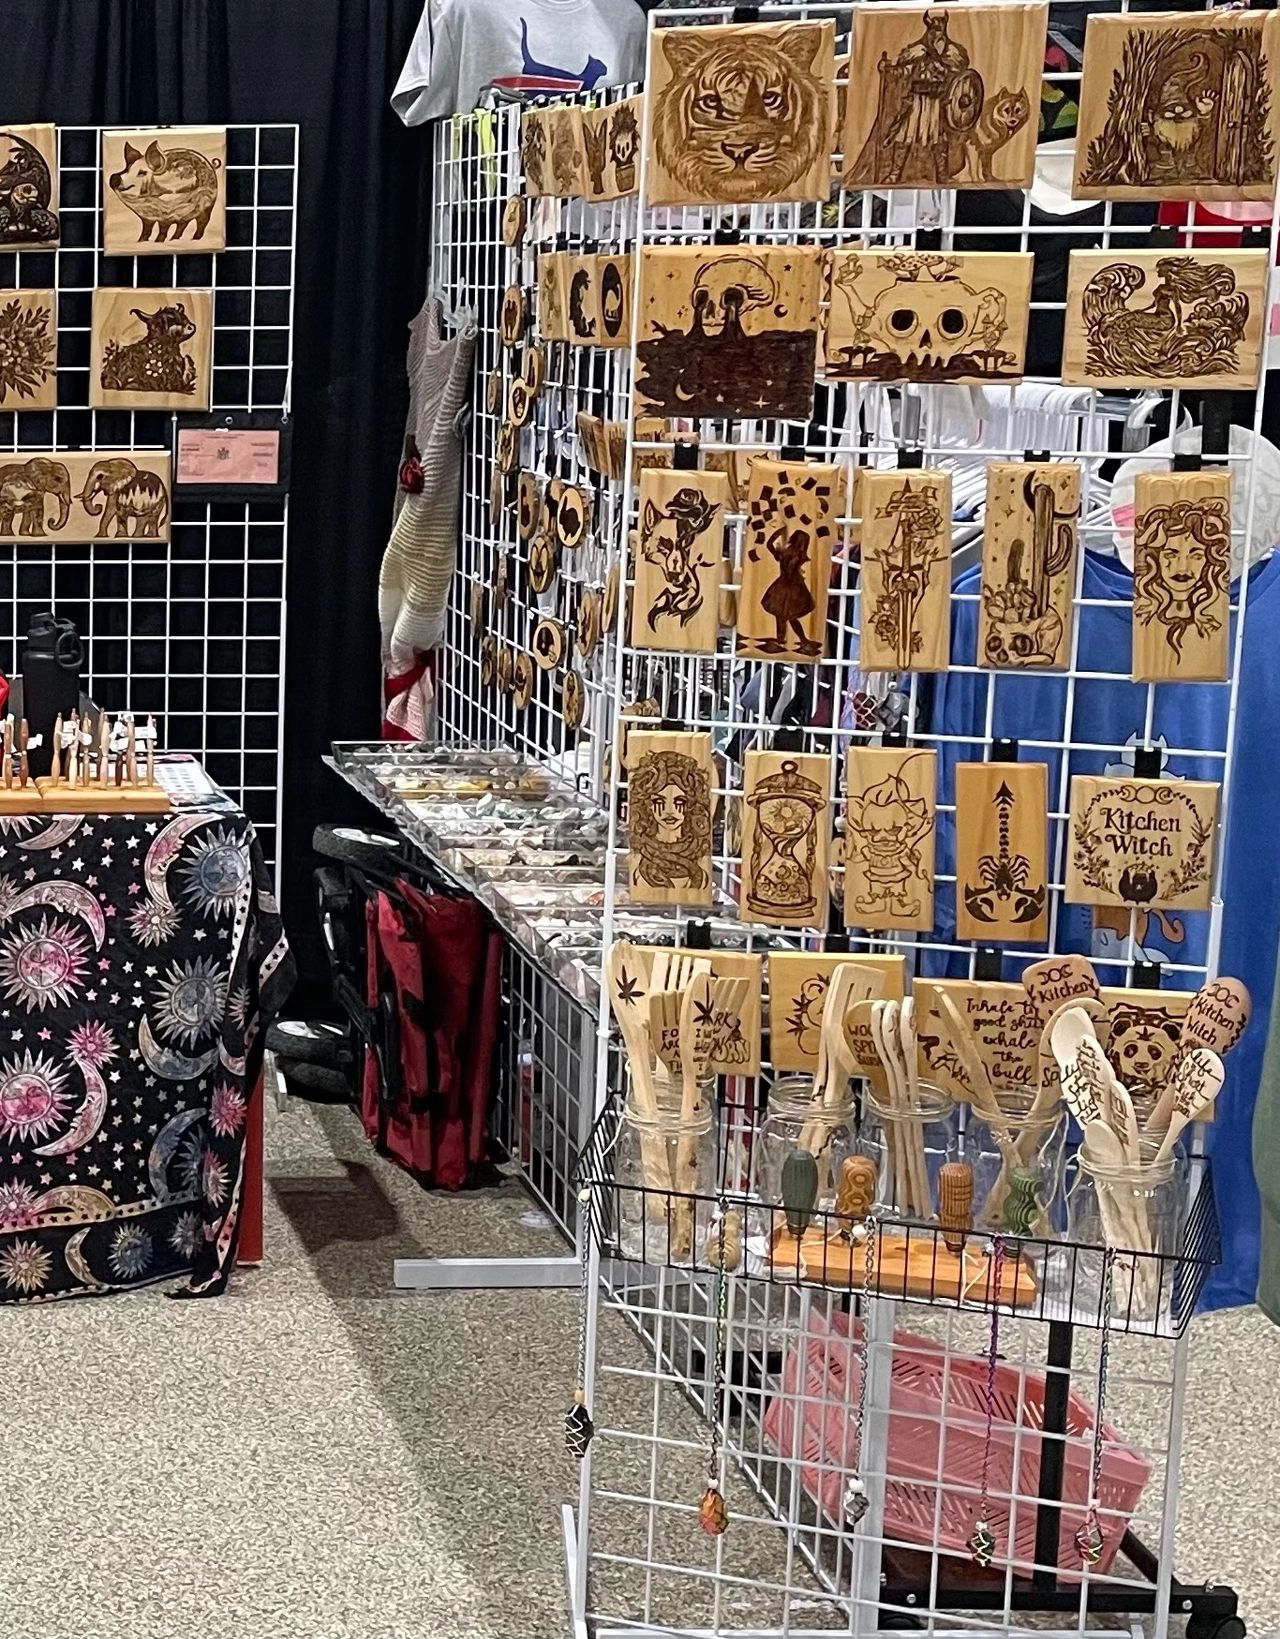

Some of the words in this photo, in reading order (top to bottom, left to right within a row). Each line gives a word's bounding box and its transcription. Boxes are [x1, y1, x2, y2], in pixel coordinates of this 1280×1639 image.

[1100, 807, 1182, 834] Kitchen
[1105, 835, 1173, 857] Witch
[1039, 980, 1089, 1003] Kitchen
[966, 998, 1015, 1014] Inhale
[1195, 996, 1235, 1031] Kitchen
[983, 1031, 1037, 1049] exhale
[1186, 1015, 1217, 1045] Witch
